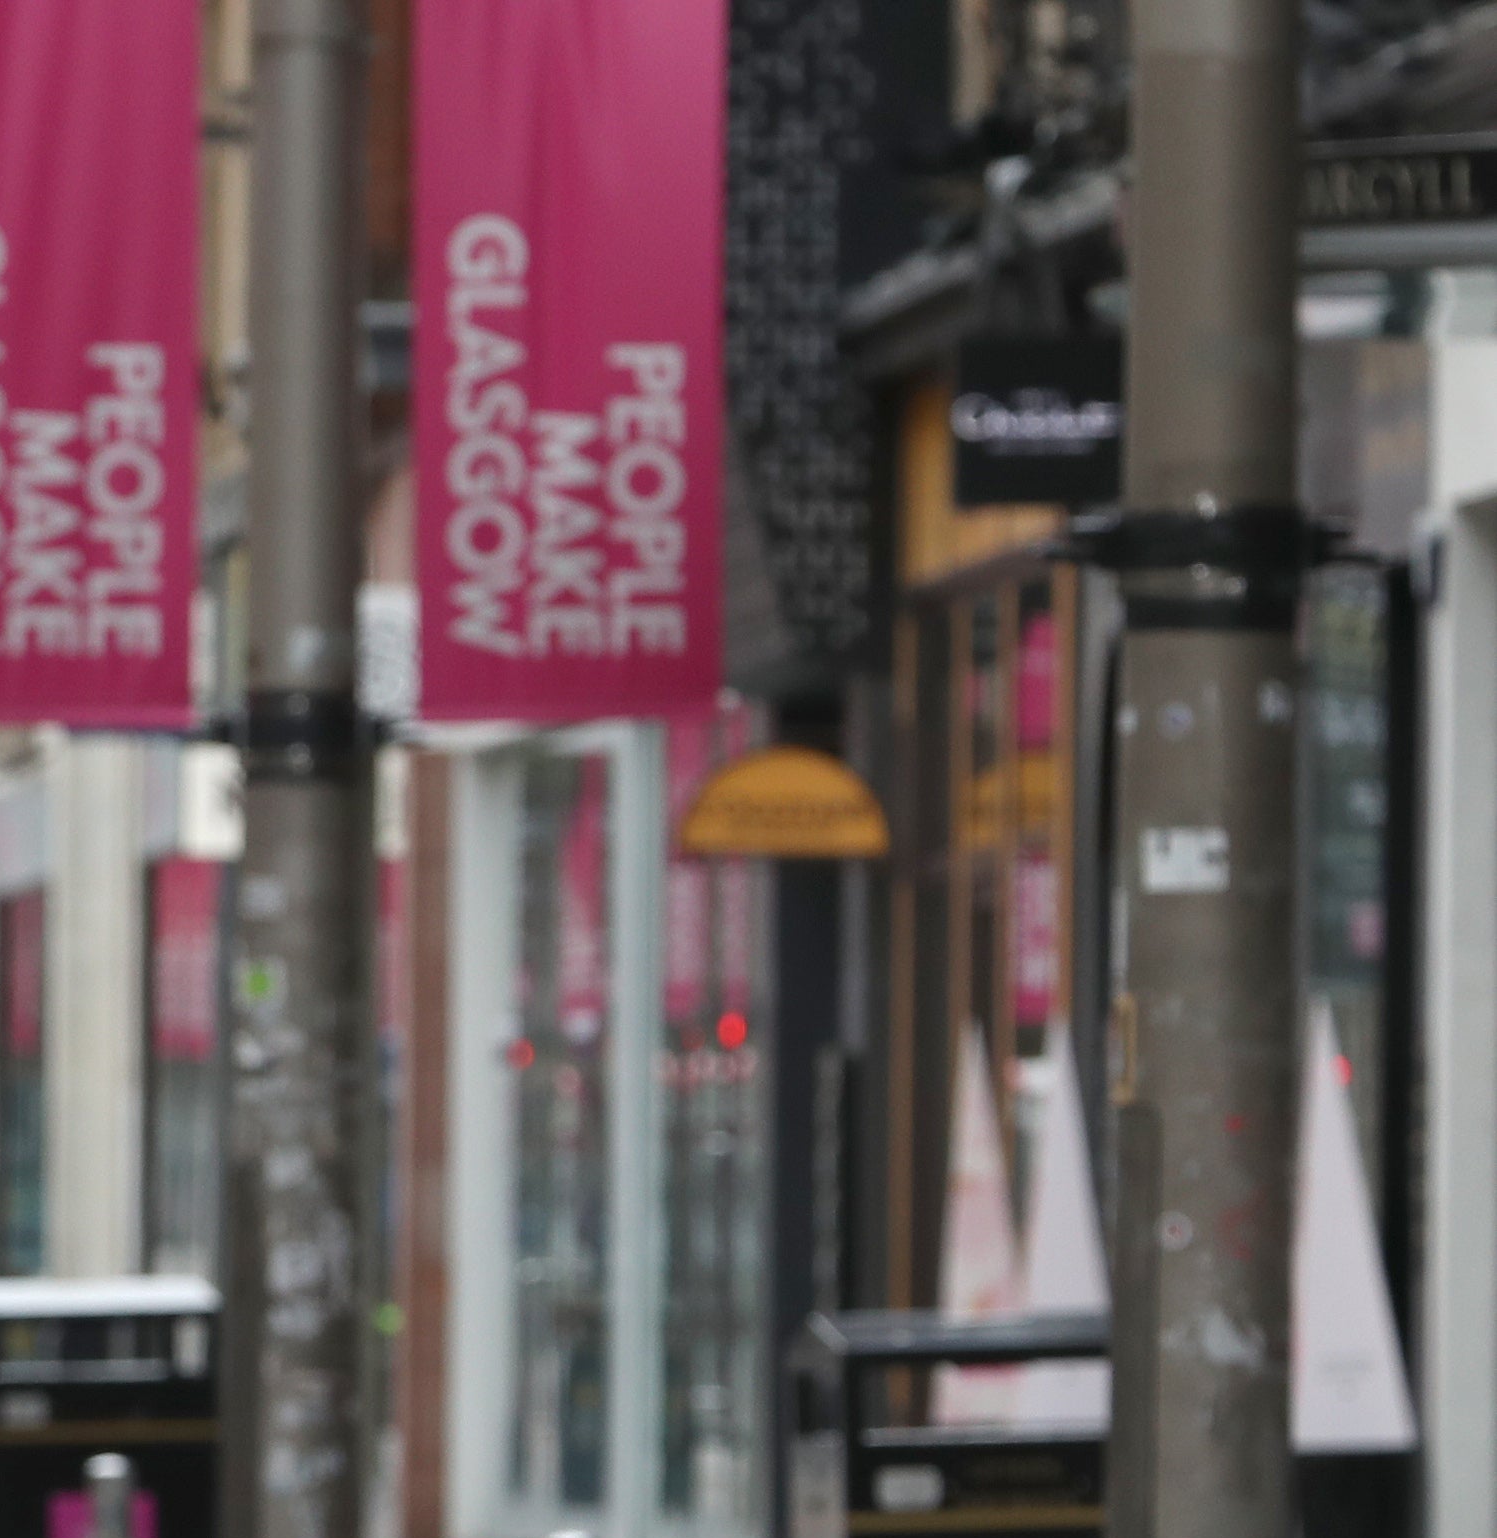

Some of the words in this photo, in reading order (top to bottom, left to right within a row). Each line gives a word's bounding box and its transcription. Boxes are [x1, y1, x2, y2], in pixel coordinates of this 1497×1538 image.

[8, 408, 82, 658] MAKE
[85, 342, 167, 658] PEOPLE
[445, 212, 530, 657] GLASGOW
[527, 409, 603, 658] MAKE
[606, 341, 687, 657] PEOPLE
